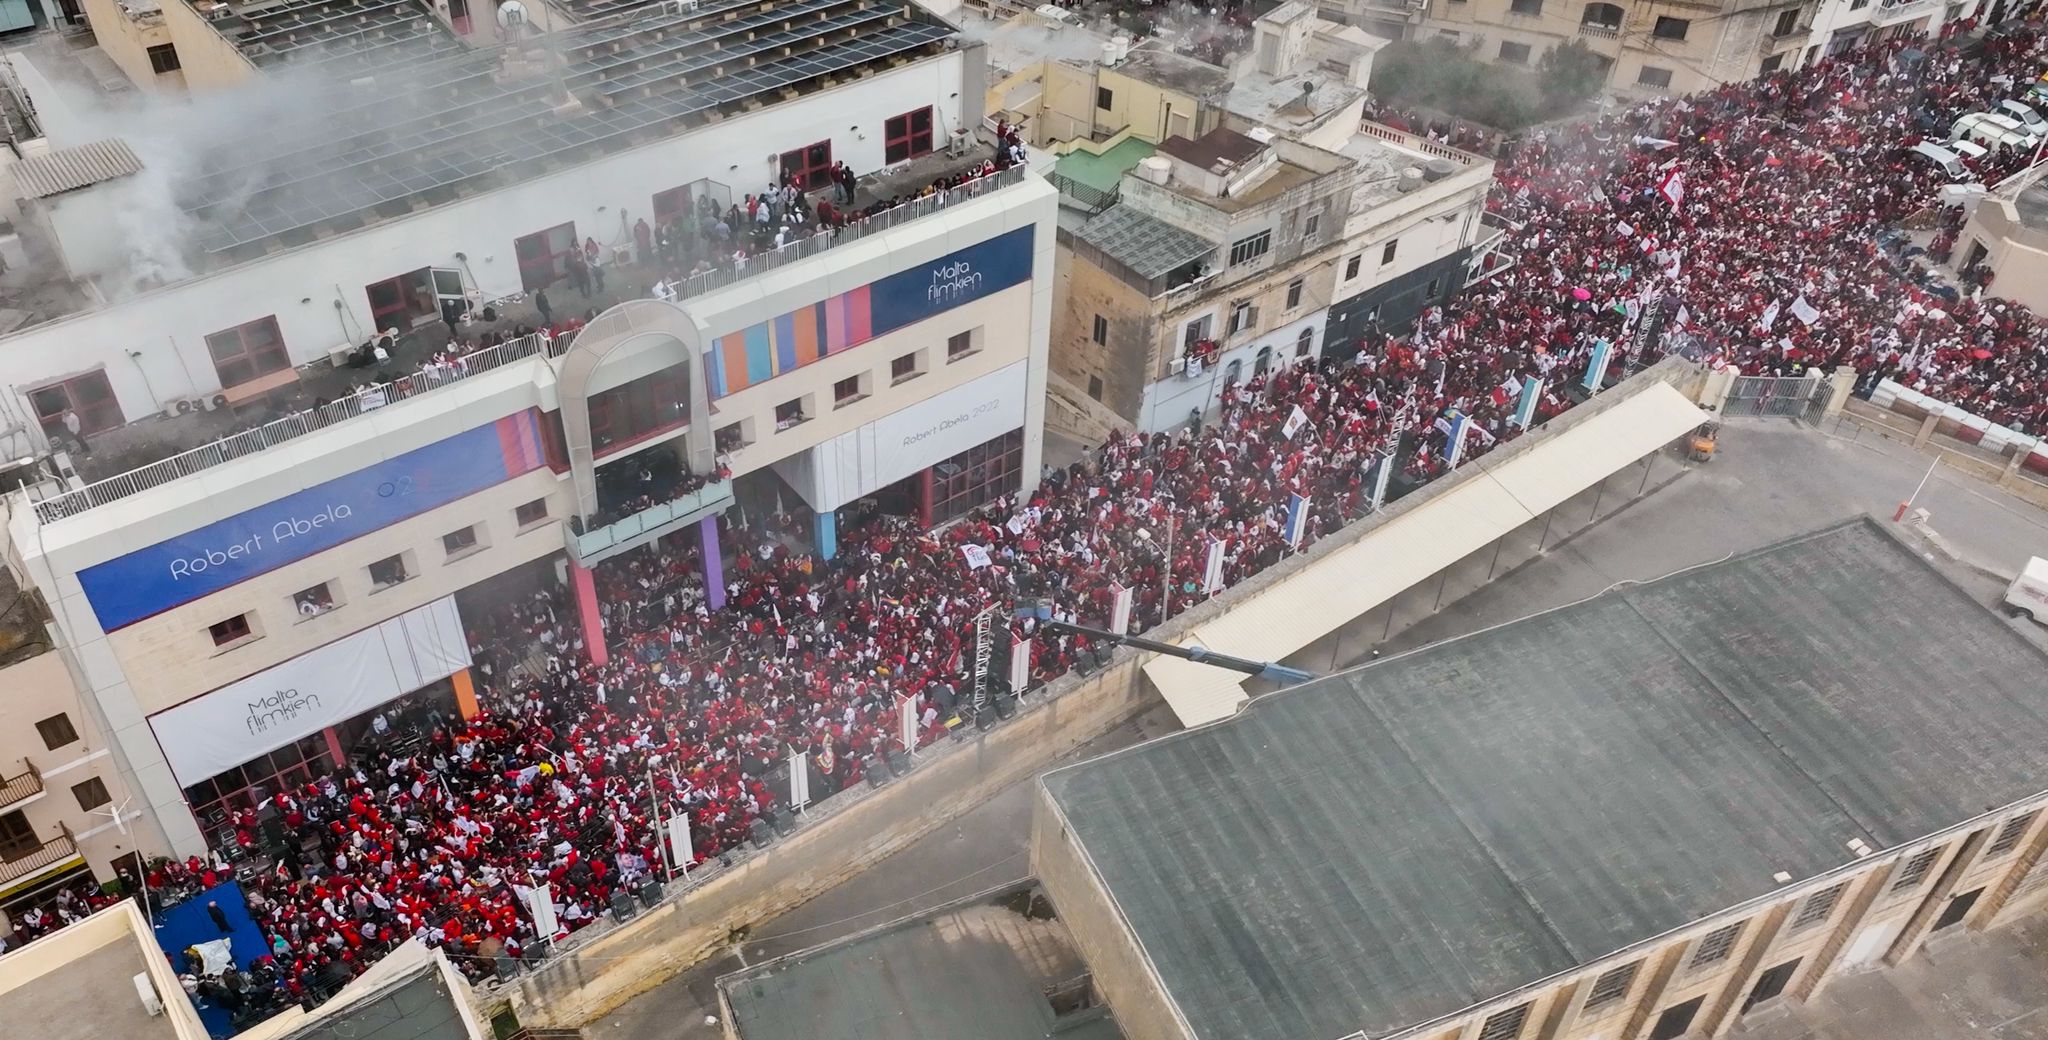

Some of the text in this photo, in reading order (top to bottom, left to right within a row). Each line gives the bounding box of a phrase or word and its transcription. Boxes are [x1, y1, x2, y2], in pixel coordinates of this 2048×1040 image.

[927, 271, 982, 305] flimkien
[933, 260, 970, 285] Malta
[902, 398, 1001, 448] Robert Abela 2022
[169, 533, 263, 581] Robert
[271, 503, 352, 544] Abela
[246, 694, 322, 737] flimkien
[247, 688, 299, 715] Malta
